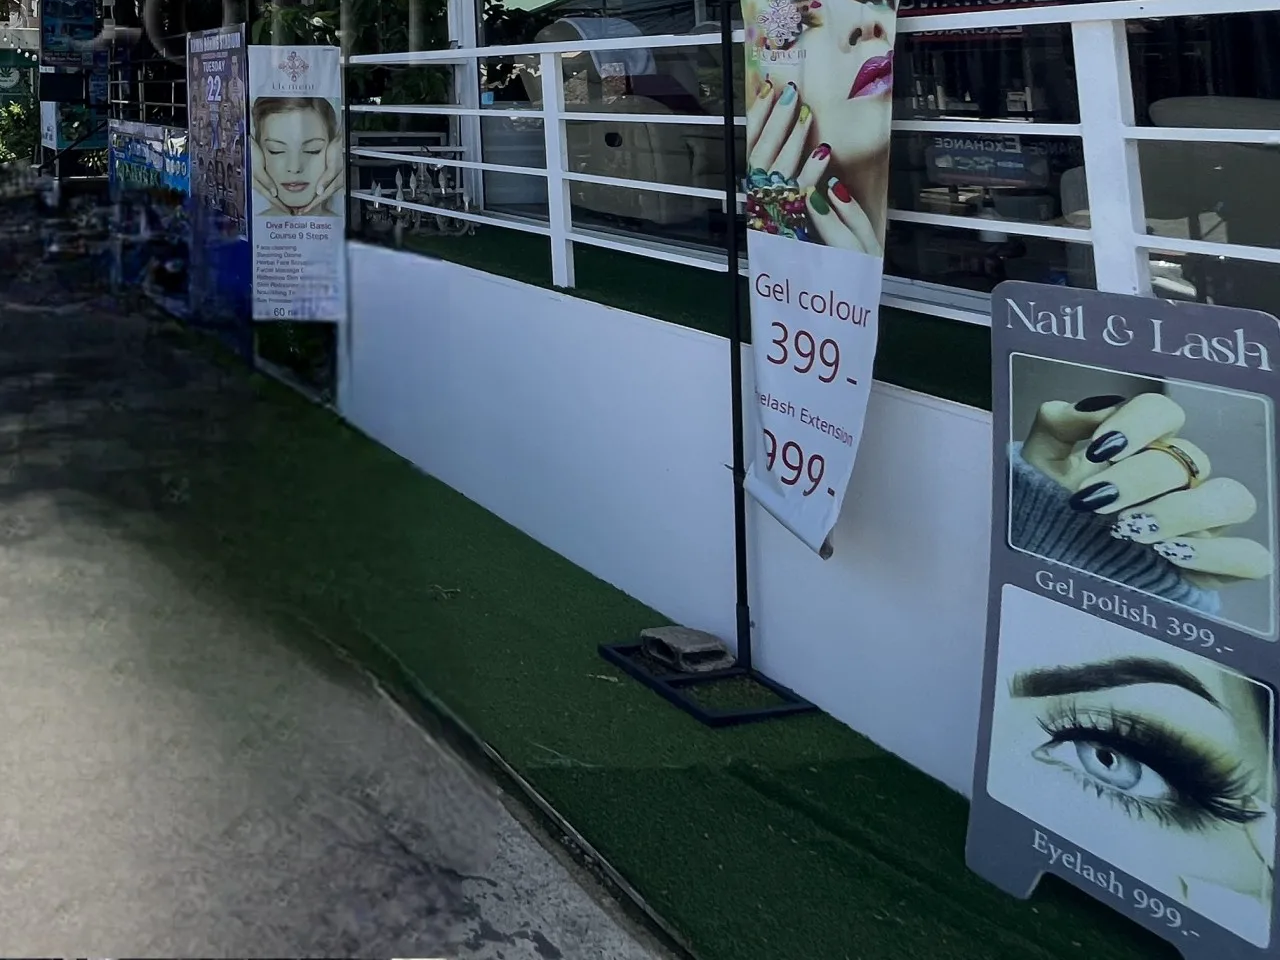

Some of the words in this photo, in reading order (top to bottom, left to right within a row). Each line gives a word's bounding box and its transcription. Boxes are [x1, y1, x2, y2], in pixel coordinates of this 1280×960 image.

[203, 60, 226, 72] TUESDAY
[207, 75, 222, 102] 22
[266, 221, 283, 229] Diva
[285, 221, 307, 229] Facial
[310, 222, 332, 230] Basic
[269, 232, 297, 240] Course
[306, 233, 329, 241] Steps
[273, 307, 286, 317] 60
[755, 272, 790, 304] Gel
[798, 290, 872, 328] colour
[766, 321, 858, 386] 399-
[1005, 297, 1087, 341] Nail
[1102, 314, 1135, 347] &
[1150, 318, 1273, 371] Lash
[755, 390, 795, 418] elash
[800, 407, 853, 447] Extension
[1035, 570, 1075, 599] Gel
[1082, 590, 1159, 630] polish
[1166, 617, 1235, 653] 399.-
[1031, 829, 1125, 900] Eyelash
[1132, 888, 1201, 938] 999.-
